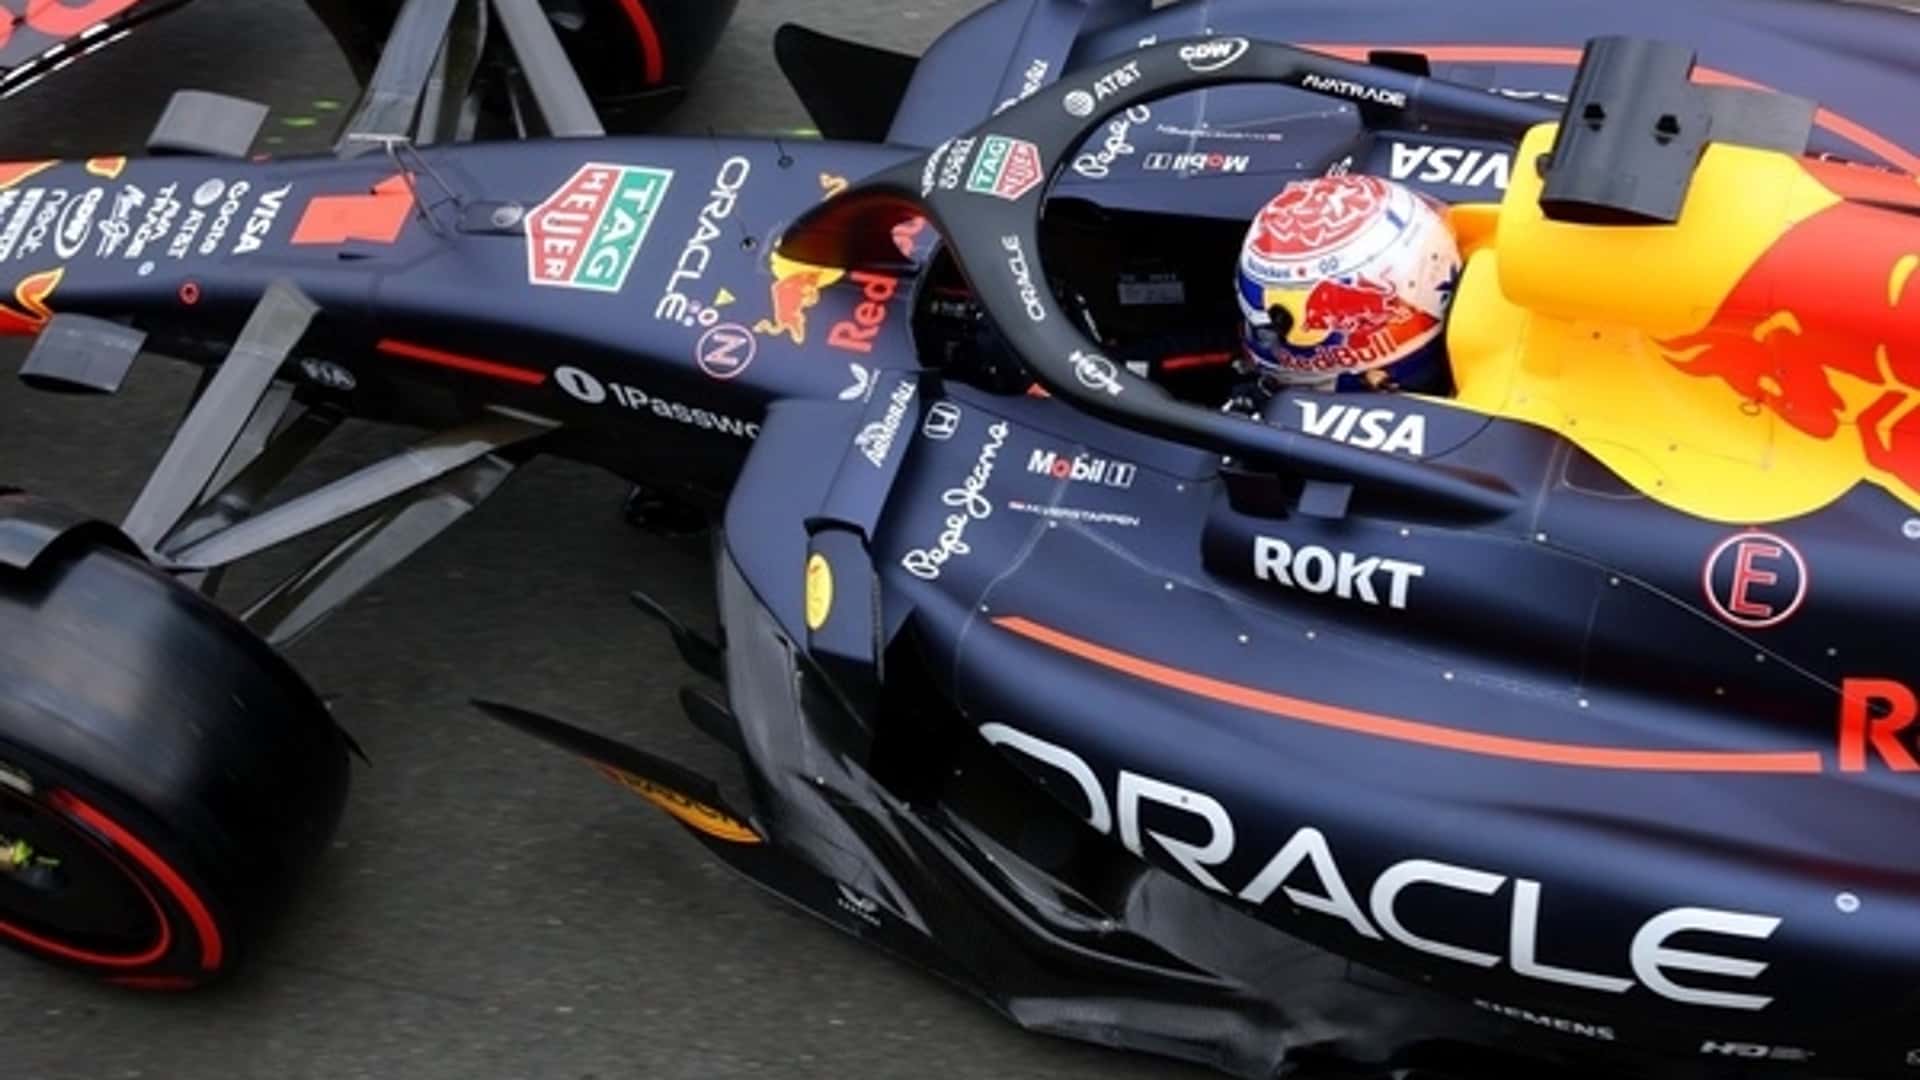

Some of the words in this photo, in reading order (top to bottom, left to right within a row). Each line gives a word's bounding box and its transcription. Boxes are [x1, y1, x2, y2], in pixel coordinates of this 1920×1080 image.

[1092, 60, 1142, 101] AT&T
[1302, 74, 1407, 107] AVATRADE
[975, 139, 1008, 187] TAG
[1072, 118, 1135, 179] Pepe
[1172, 152, 1249, 175] Mobil
[1390, 143, 1509, 189] VISA
[166, 207, 205, 259] AT&T
[232, 181, 292, 254] VISA
[541, 171, 609, 278] HEUER
[586, 178, 656, 278] TAG
[655, 156, 750, 321] ORACLE
[1002, 235, 1047, 322] ORACLE
[827, 271, 898, 353] Red
[608, 382, 762, 440] 1Passwo
[1292, 399, 1426, 456] VISA
[1027, 449, 1107, 483] Mobil
[902, 513, 970, 579] Pepe
[941, 420, 1009, 519] Jeans
[1254, 536, 1425, 609] ROKT
[1839, 677, 1920, 772] R
